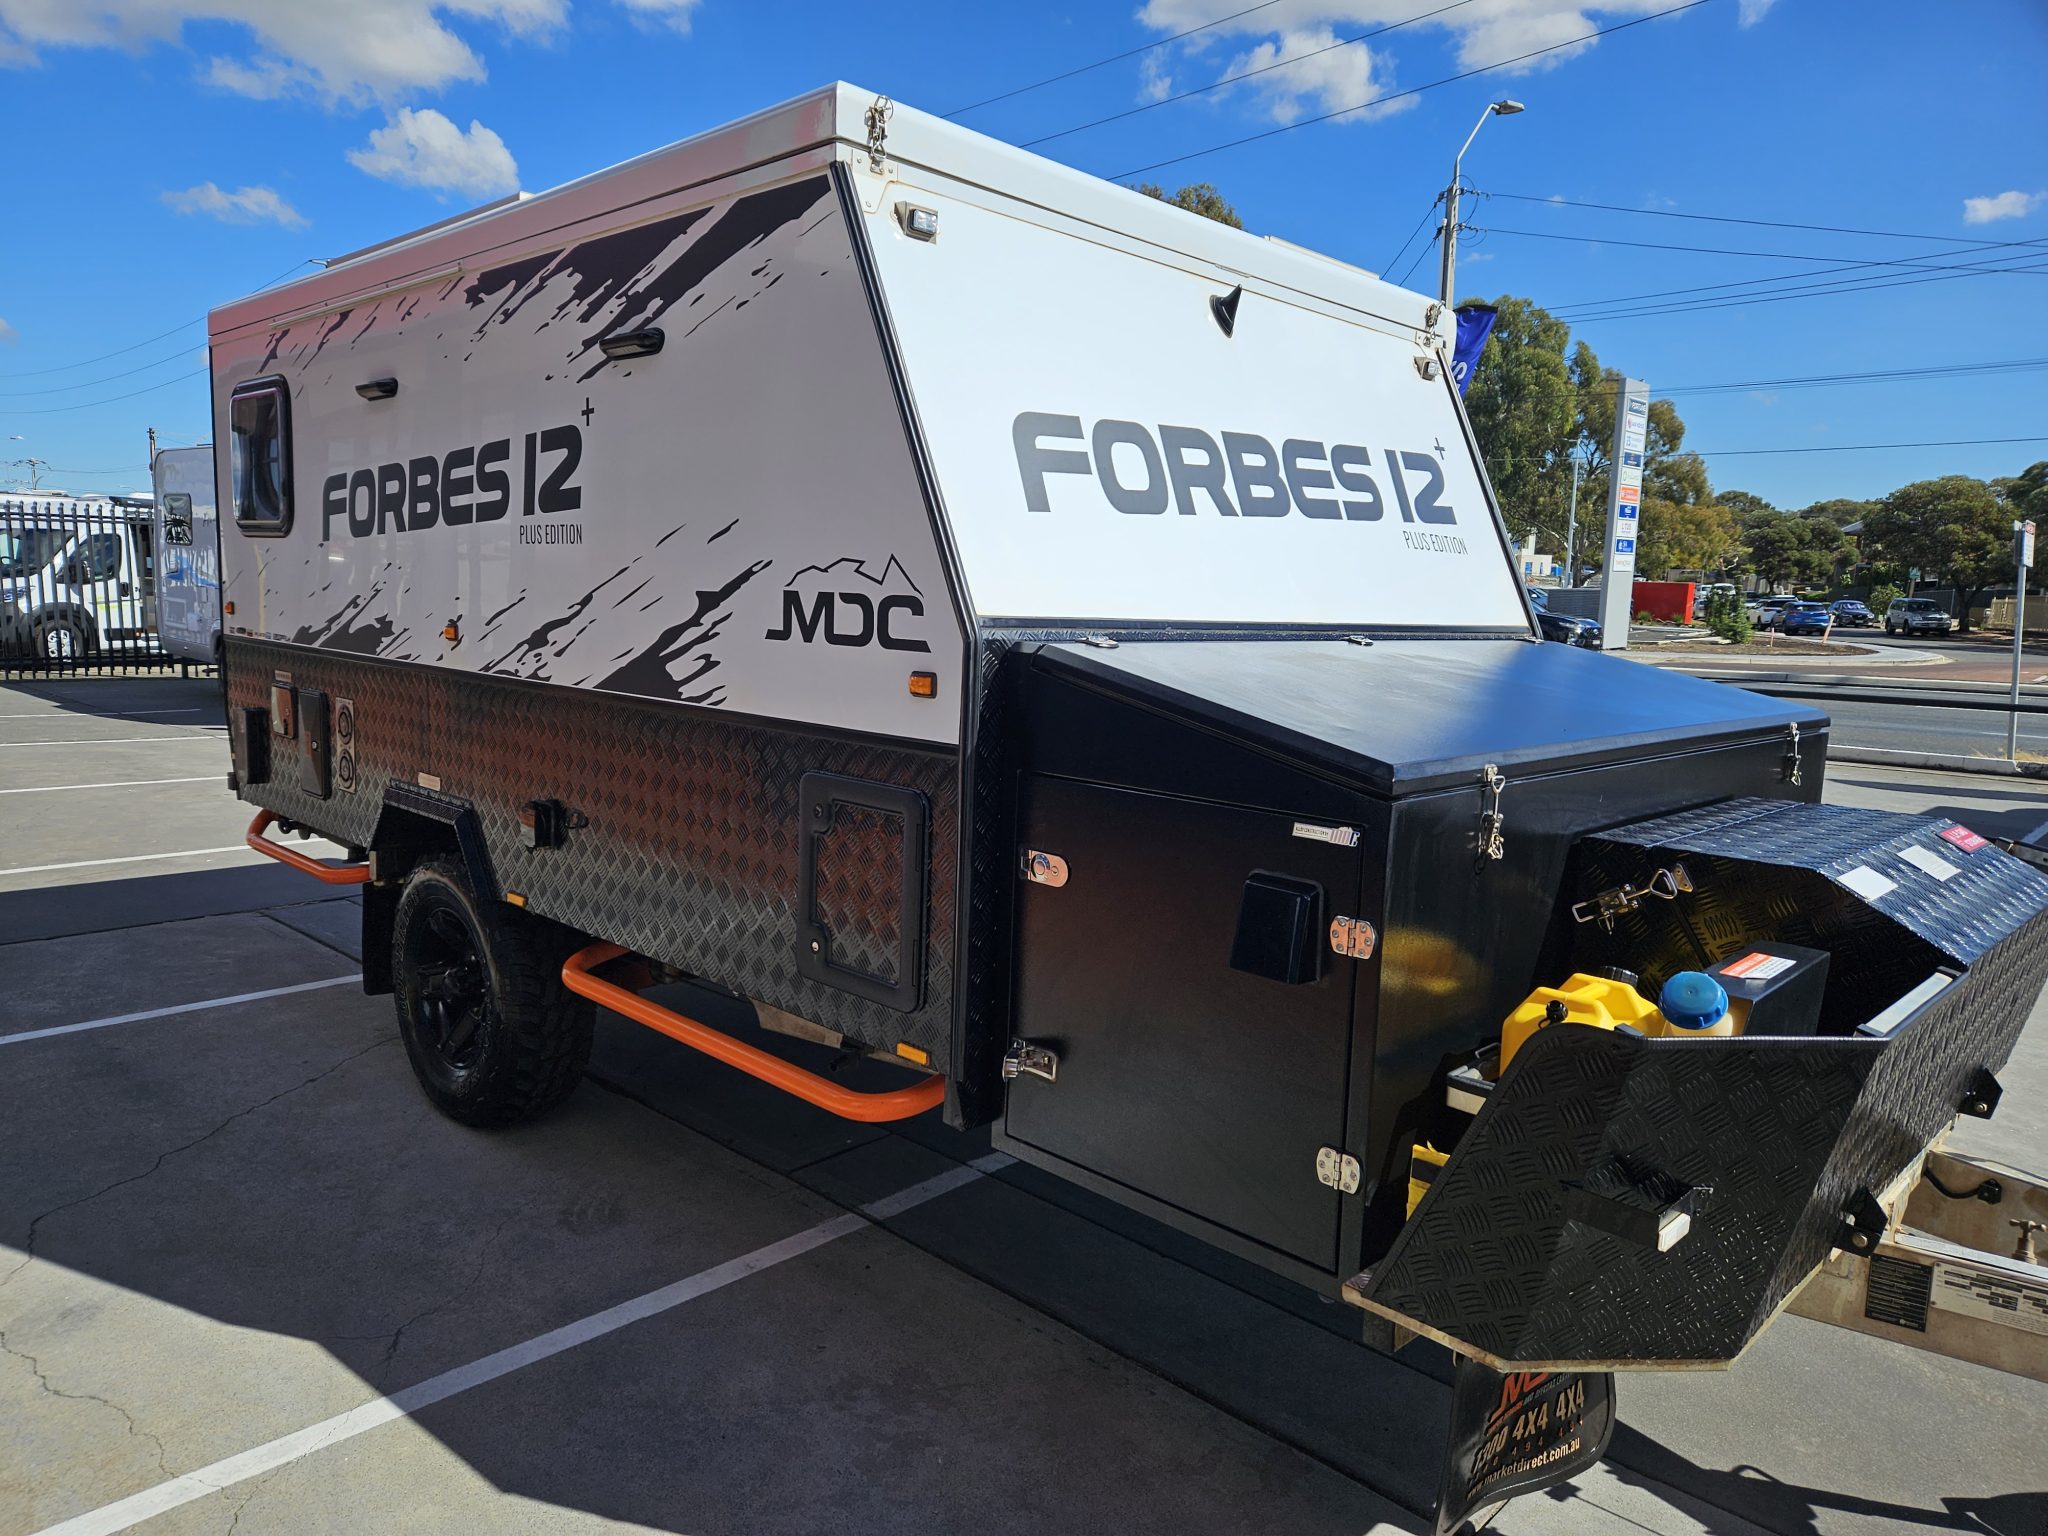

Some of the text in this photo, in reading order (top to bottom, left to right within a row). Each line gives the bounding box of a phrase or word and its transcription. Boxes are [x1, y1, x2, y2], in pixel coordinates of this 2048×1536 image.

[322, 438, 510, 542] FORBES
[1012, 411, 1384, 521] FORBES
[520, 523, 583, 545] PLUS EDITION
[1403, 530, 1469, 556] PLUS EDITION
[765, 589, 932, 654] MDC
[1512, 1402, 1548, 1440] 4X4
[1555, 1379, 1585, 1420] 4X4
